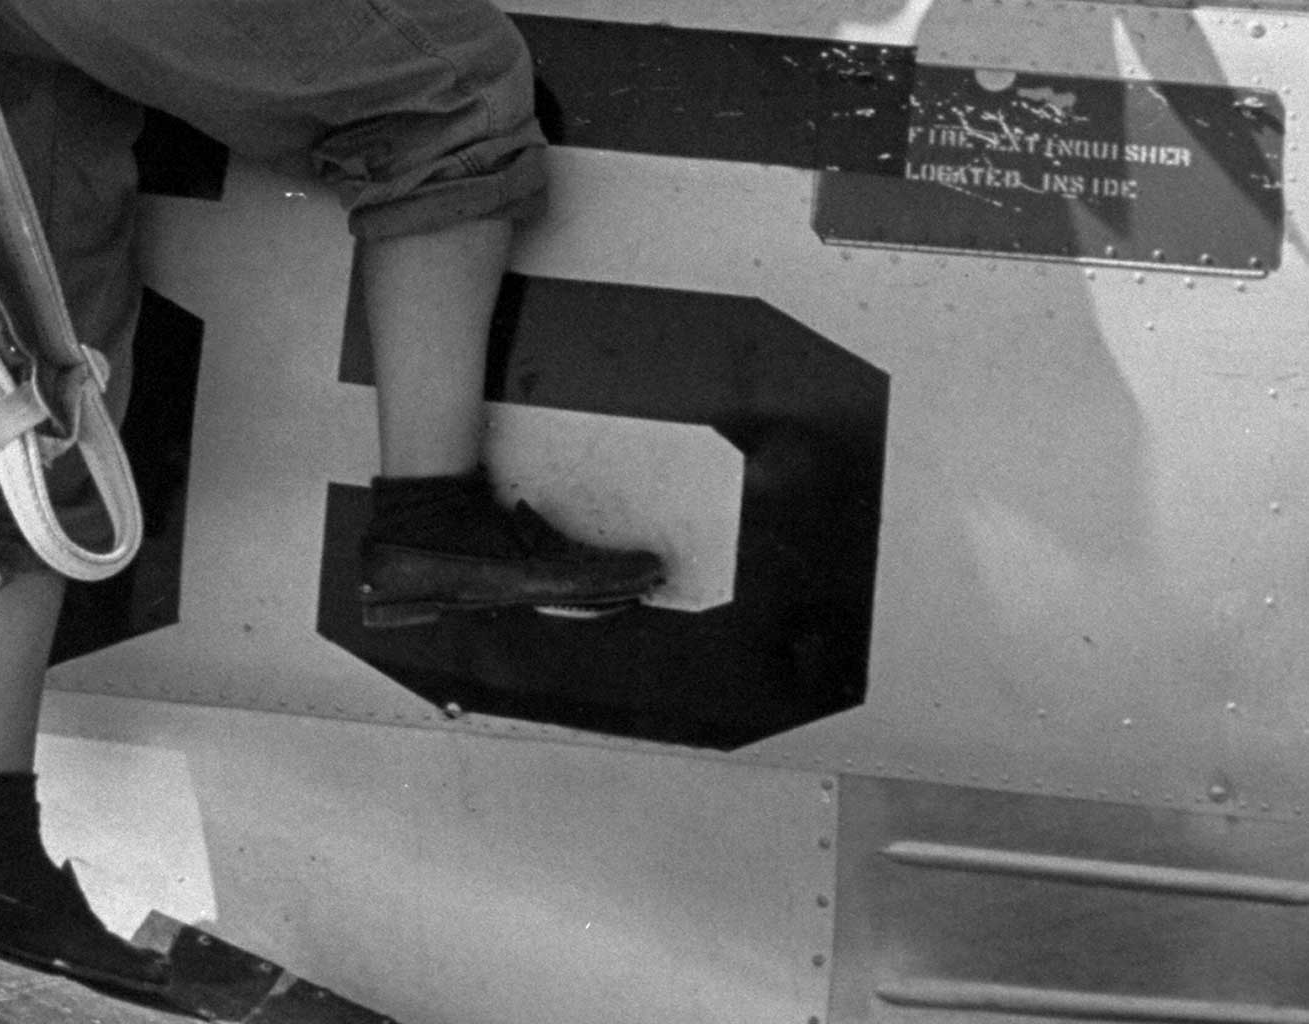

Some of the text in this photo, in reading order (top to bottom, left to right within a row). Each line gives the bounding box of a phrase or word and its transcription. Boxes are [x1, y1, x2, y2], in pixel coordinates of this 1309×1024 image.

[907, 126, 974, 148] FIRE
[905, 161, 1139, 199] LOCATED INSIDE
